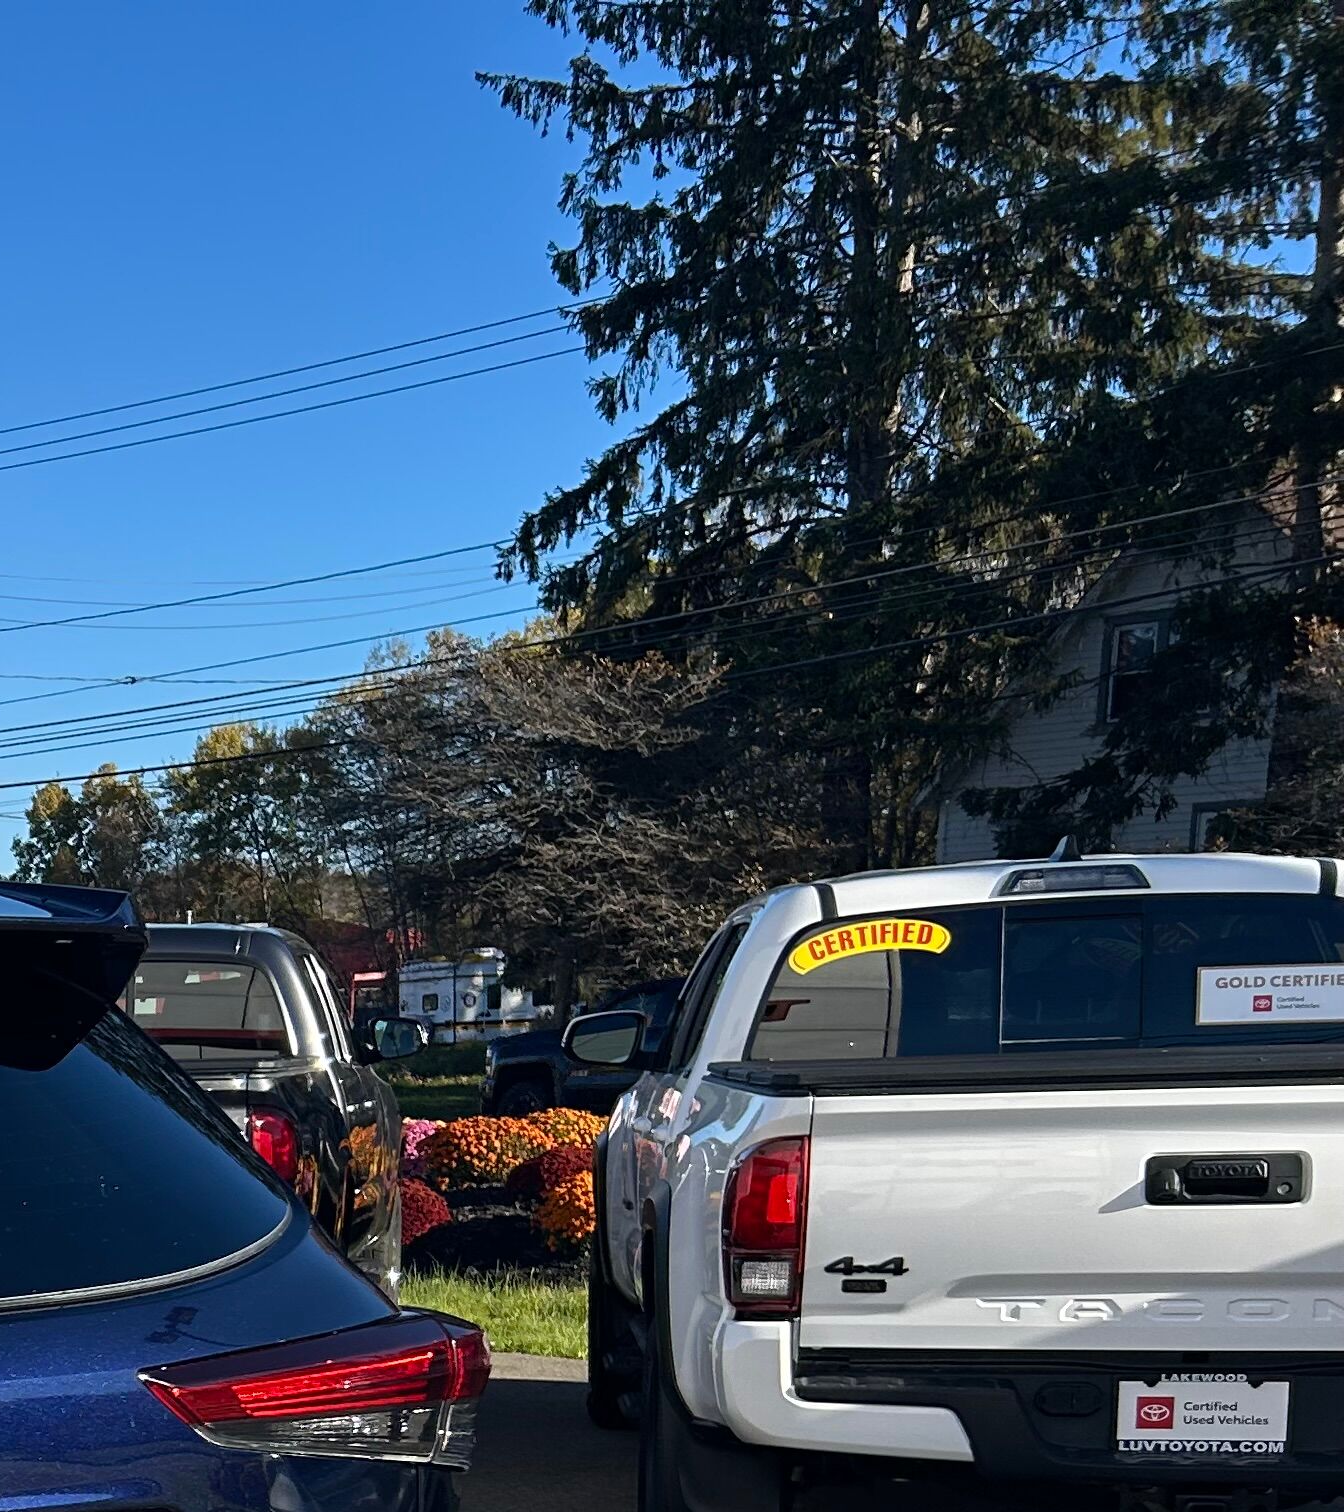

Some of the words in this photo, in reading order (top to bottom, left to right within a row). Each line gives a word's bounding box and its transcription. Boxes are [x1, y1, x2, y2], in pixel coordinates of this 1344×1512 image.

[807, 922, 933, 961] CERTIFIED
[1215, 976, 1266, 989] GOLD
[1193, 1164, 1263, 1178] TOYOTA
[1161, 1373, 1248, 1382] LAKEWOOD
[1183, 1401, 1238, 1412] Certified
[1183, 1415, 1215, 1425] Used
[1218, 1415, 1269, 1425] Vehicles
[1118, 1440, 1285, 1453] LUVTOYOTA.COM
